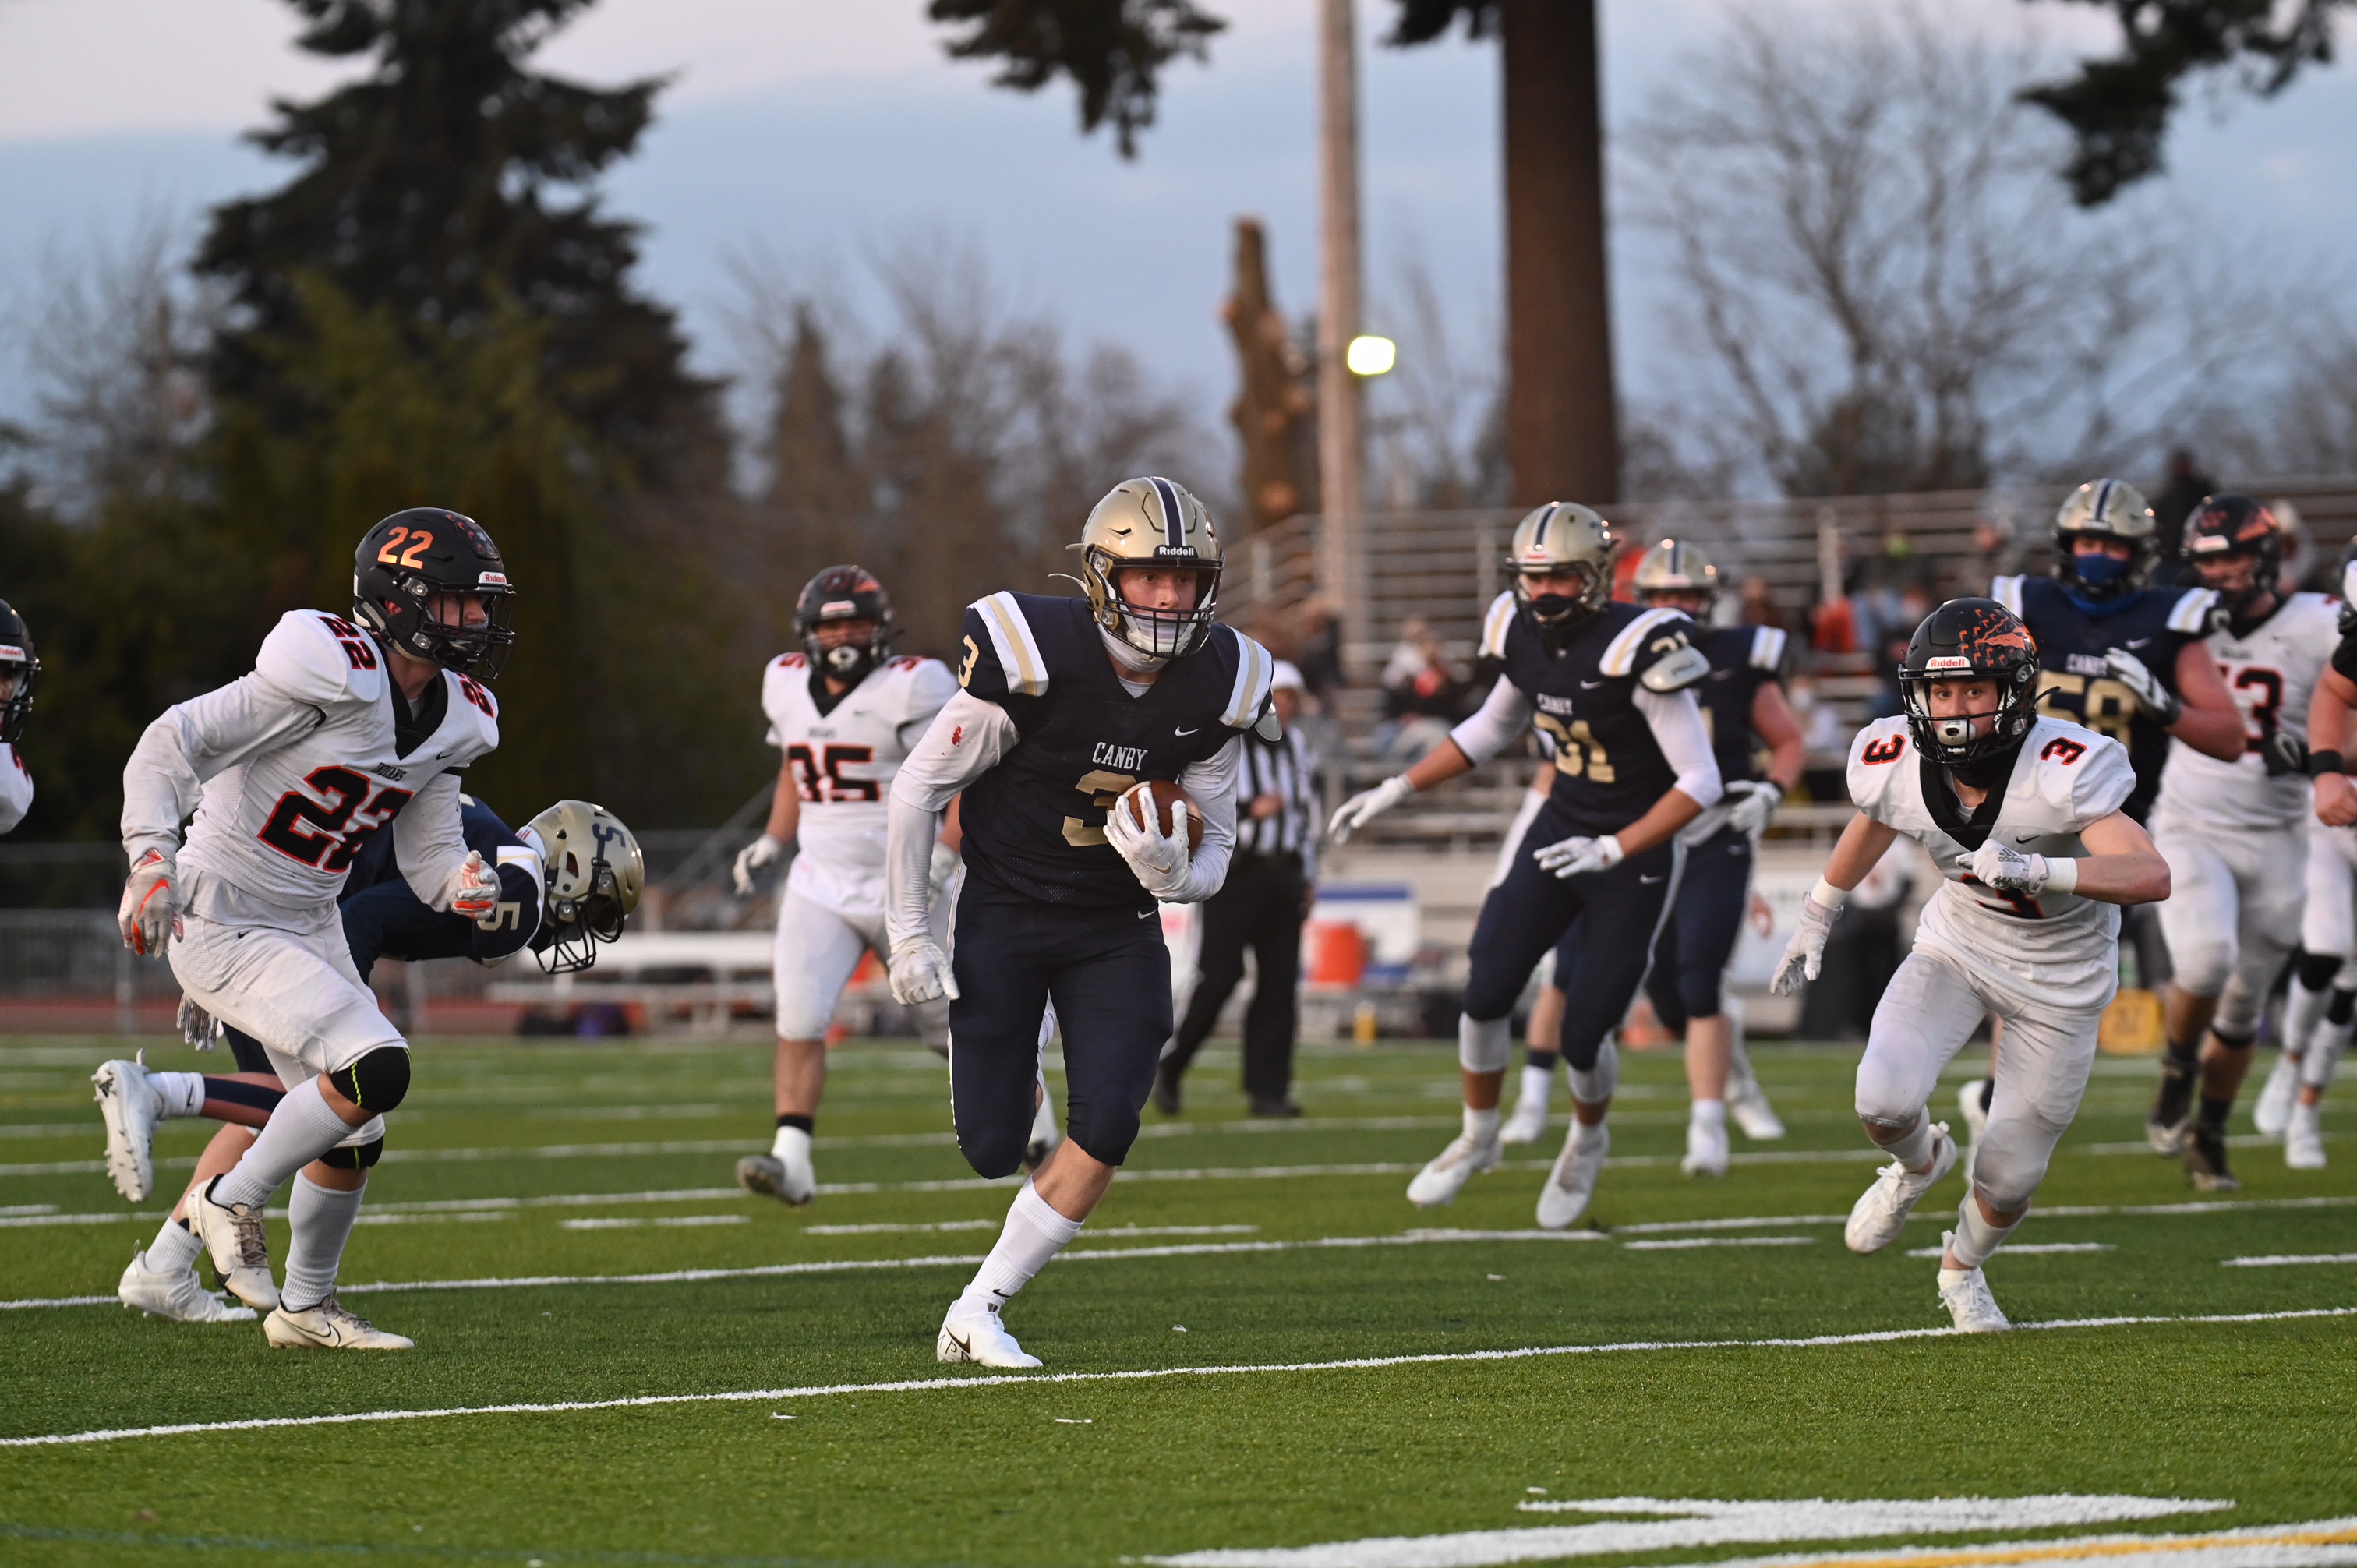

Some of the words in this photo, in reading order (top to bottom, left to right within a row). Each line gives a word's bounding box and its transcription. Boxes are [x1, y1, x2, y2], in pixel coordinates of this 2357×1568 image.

[377, 526, 434, 570] 22
[1159, 546, 1195, 556] Riddell
[316, 616, 378, 671] 22
[957, 634, 980, 688] 3
[1931, 659, 1965, 668] Riddell
[2036, 669, 2140, 760] 58
[1093, 741, 1148, 772] CANBY
[1533, 711, 1616, 784] 31
[1861, 733, 1906, 765] 3
[2041, 736, 2088, 766] 3
[370, 761, 408, 782] INDIANS
[256, 765, 415, 874] 22
[1062, 768, 1138, 847] 3
[476, 901, 521, 931] 5
